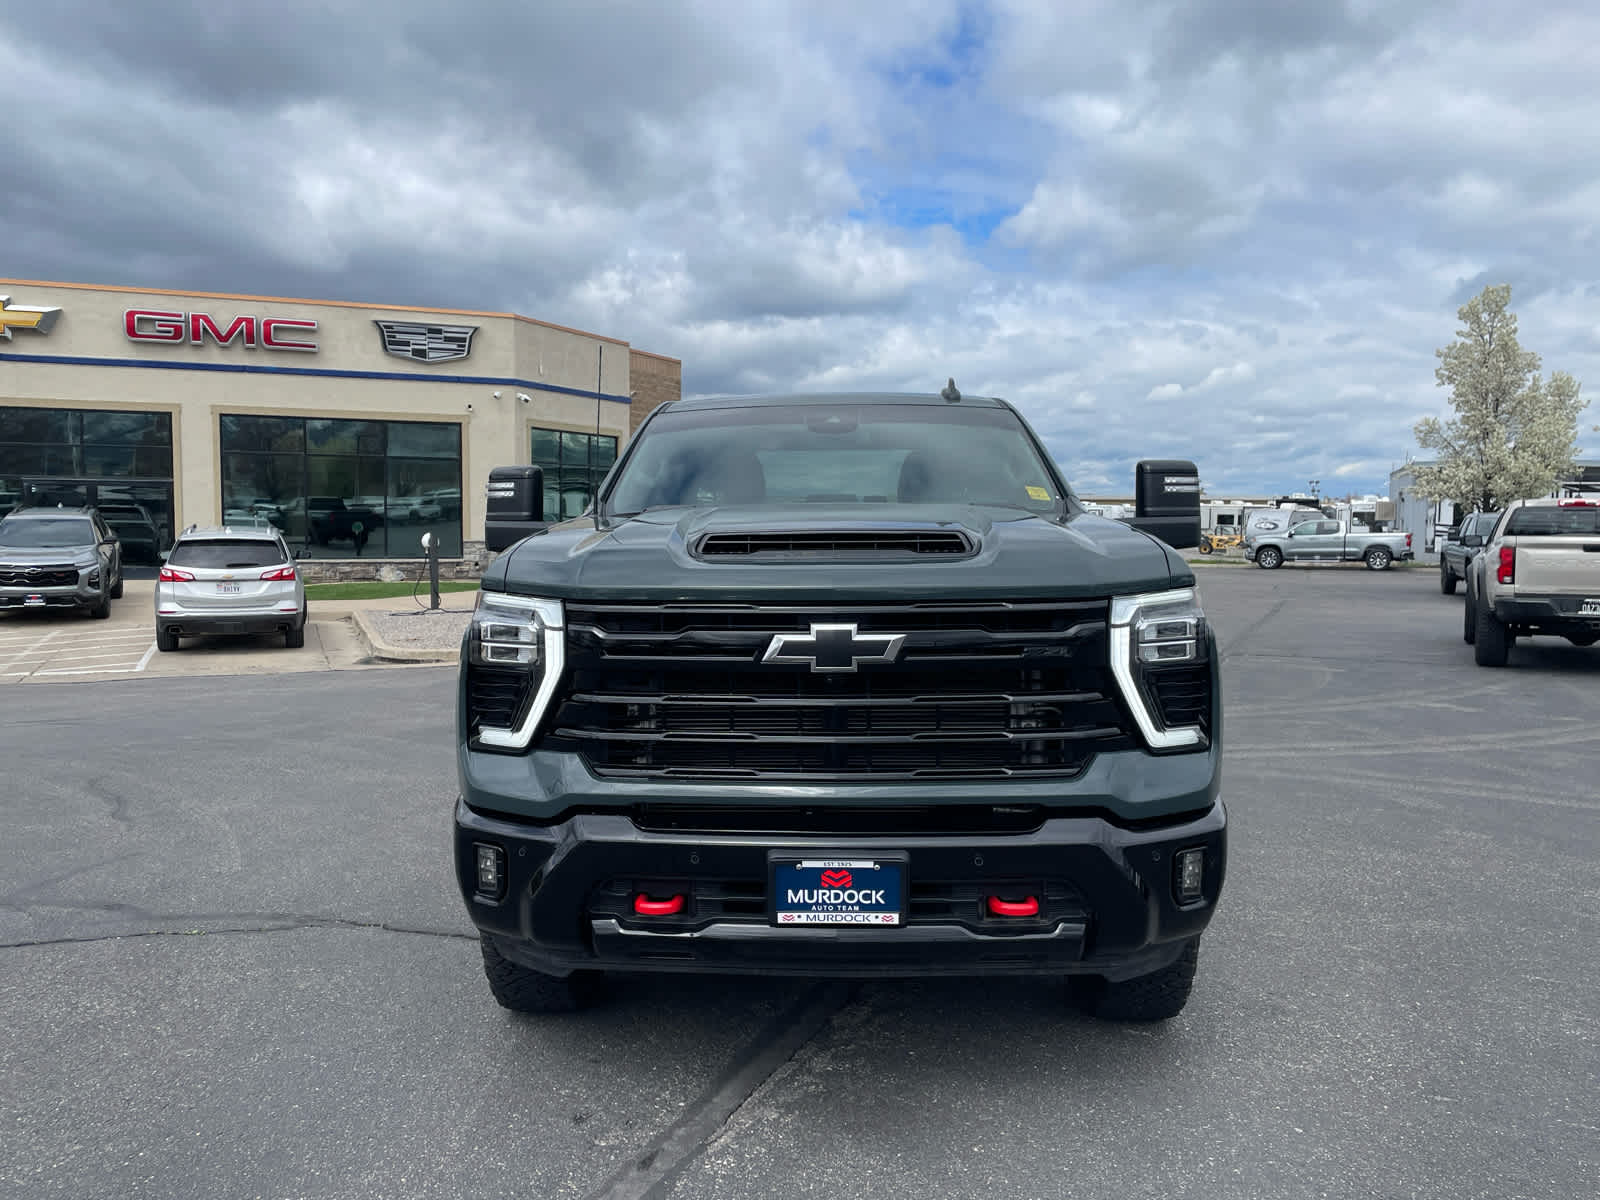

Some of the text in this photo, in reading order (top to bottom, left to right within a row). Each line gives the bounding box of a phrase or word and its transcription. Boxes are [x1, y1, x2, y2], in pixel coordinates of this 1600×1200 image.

[123, 308, 319, 352] GMC
[787, 889, 885, 904] MURDOCK
[806, 914, 871, 922] MURDOCK
